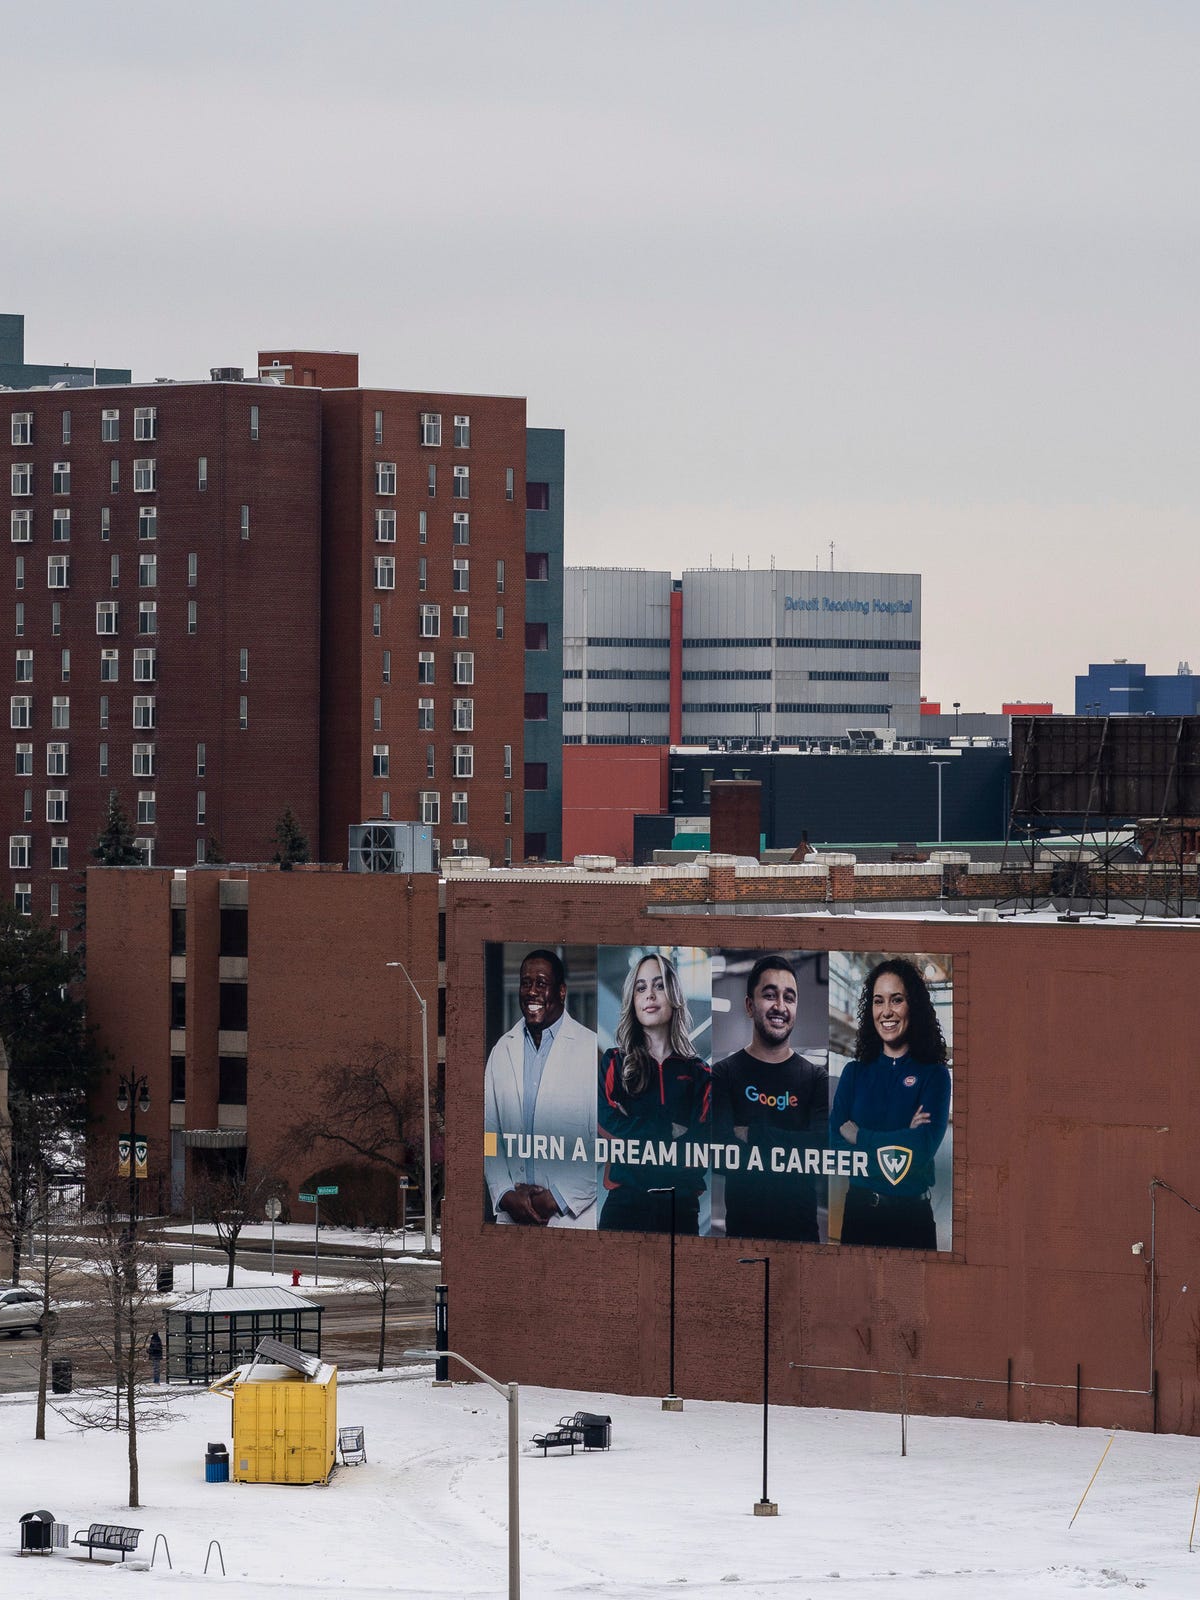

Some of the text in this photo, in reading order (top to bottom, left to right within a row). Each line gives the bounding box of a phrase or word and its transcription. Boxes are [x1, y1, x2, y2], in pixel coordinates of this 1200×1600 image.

[784, 596, 913, 615] Detroit Receiving Hospital
[745, 1085, 798, 1110] Google
[503, 1133, 869, 1177] TURN A DREAM INTO A CAREER
[883, 1154, 907, 1174] W
